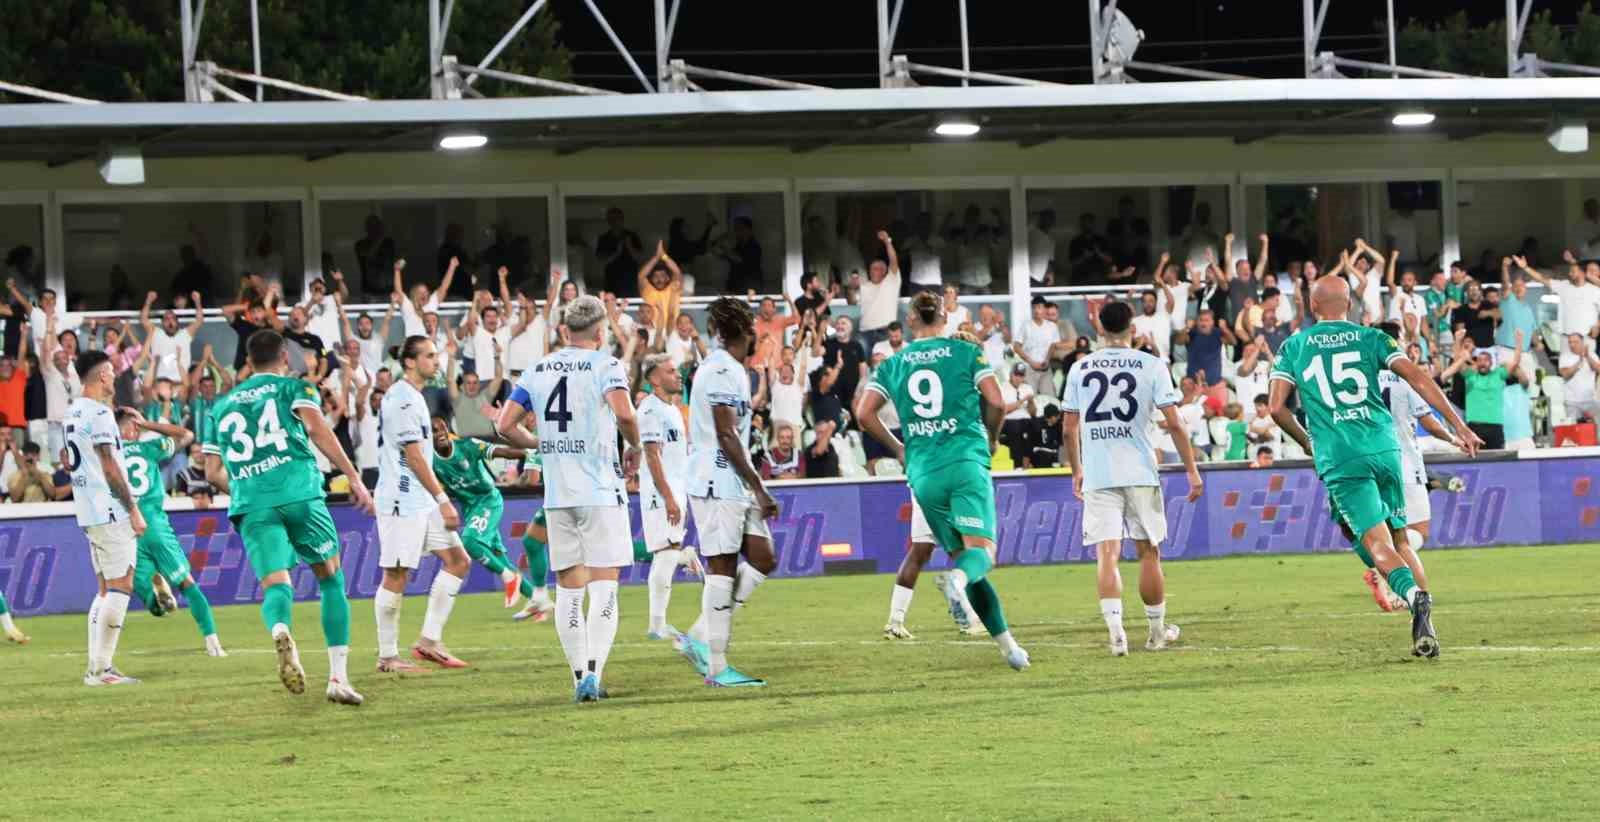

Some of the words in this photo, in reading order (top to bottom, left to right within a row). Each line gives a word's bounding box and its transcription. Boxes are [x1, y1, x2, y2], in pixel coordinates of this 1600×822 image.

[1306, 331, 1360, 346] ACROPOL
[902, 346, 952, 362] ACROPOL
[1091, 359, 1143, 370] KOZUVA
[1302, 351, 1369, 409] 15
[907, 369, 944, 419] 9
[1081, 371, 1138, 423] 23
[544, 375, 573, 433] 4
[1333, 405, 1371, 424] AJETI
[219, 398, 288, 462] 34
[1090, 426, 1133, 440] BURAK
[557, 437, 586, 454] GÜLER
[469, 515, 488, 532] 20
